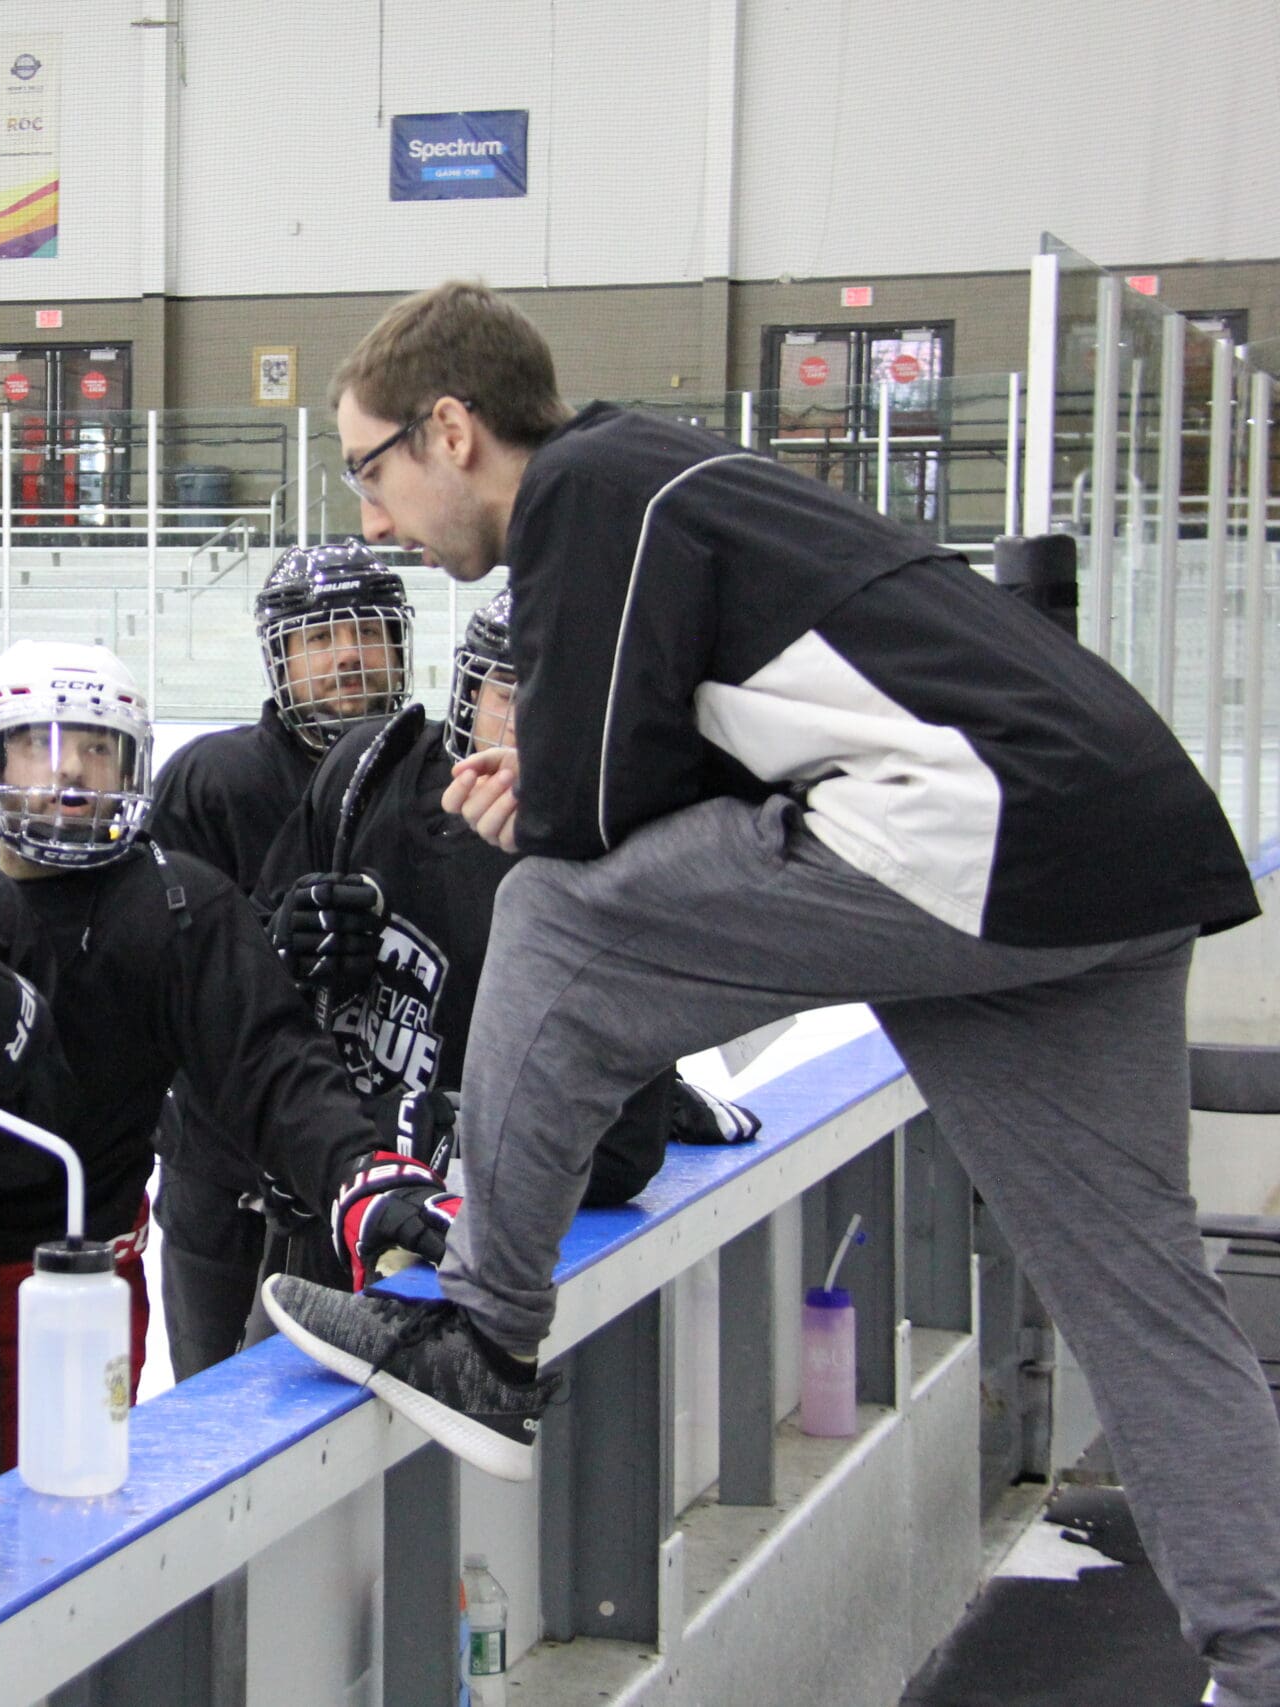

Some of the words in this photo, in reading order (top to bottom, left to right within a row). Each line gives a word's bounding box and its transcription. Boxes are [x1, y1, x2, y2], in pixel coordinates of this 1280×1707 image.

[7, 117, 43, 131] ROC
[408, 138, 502, 162] Spectrum
[51, 680, 104, 692] CCM
[44, 850, 89, 861] CCM
